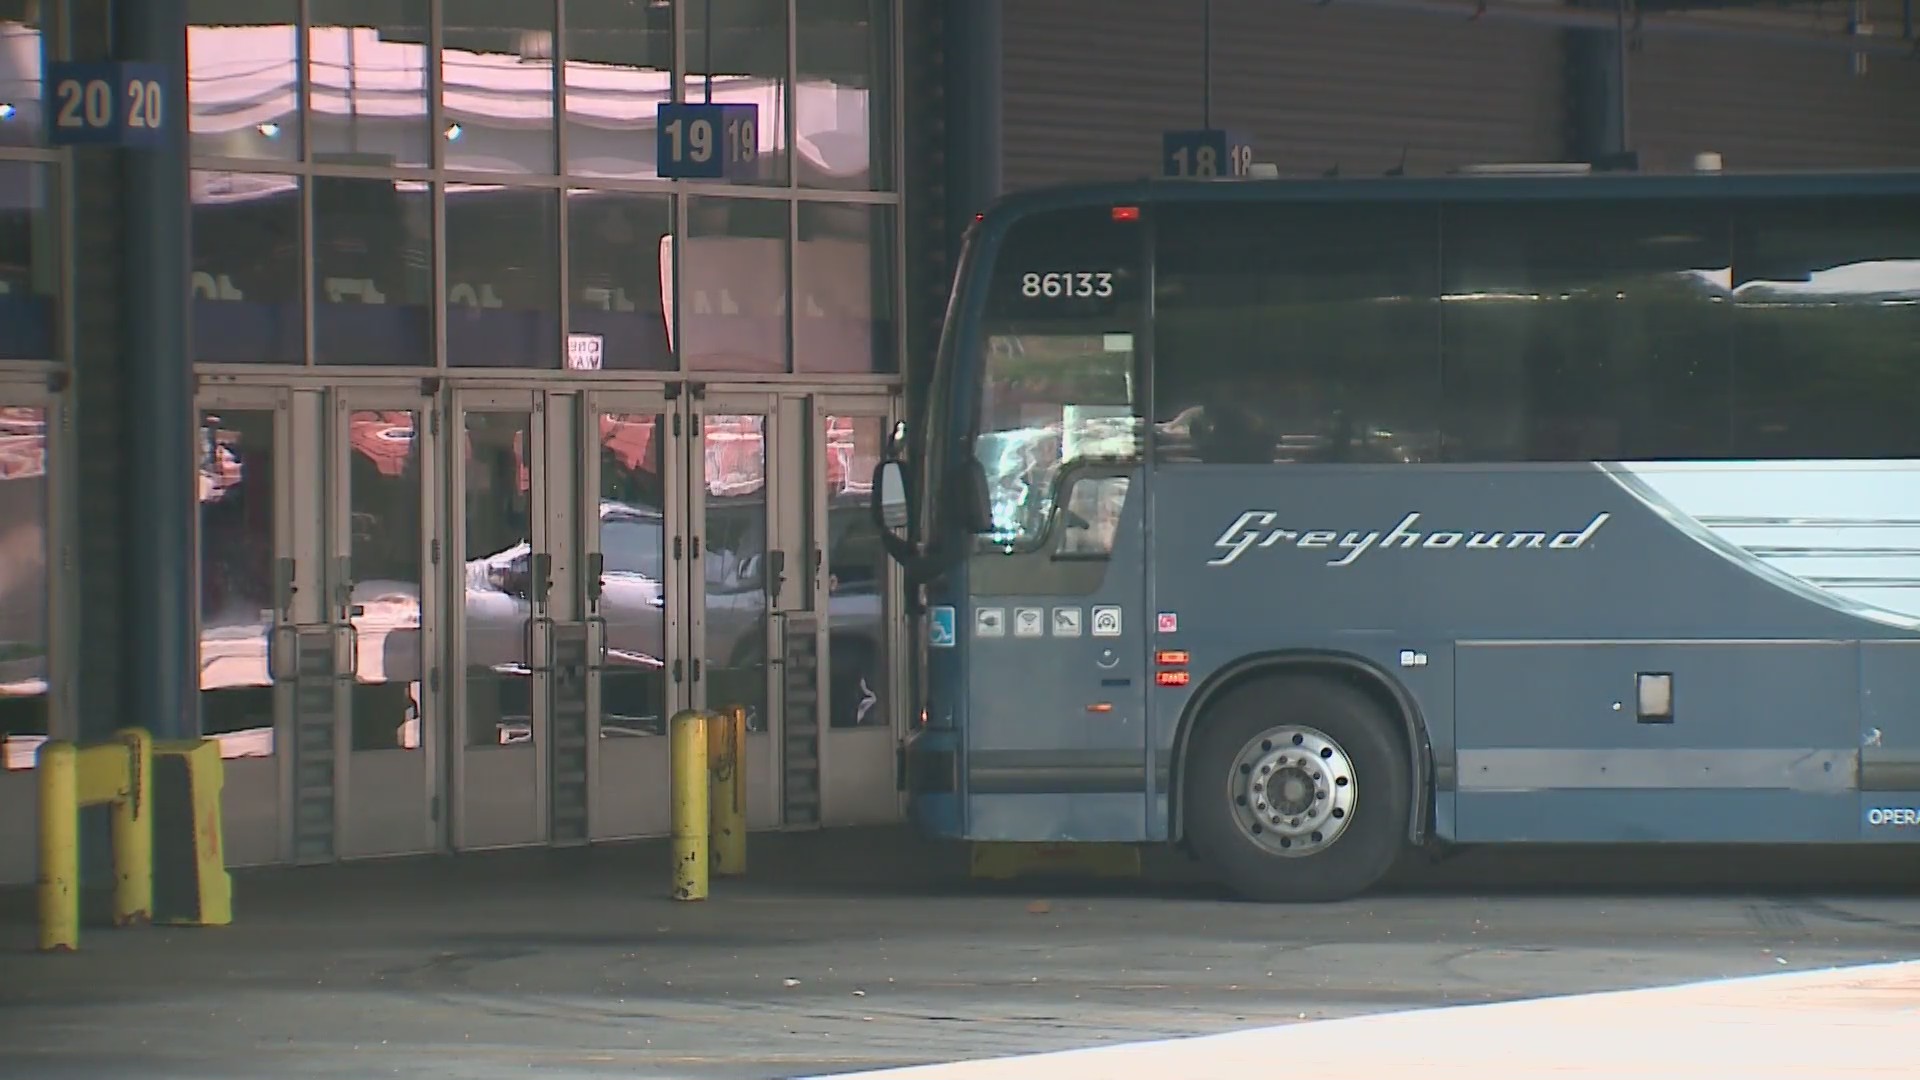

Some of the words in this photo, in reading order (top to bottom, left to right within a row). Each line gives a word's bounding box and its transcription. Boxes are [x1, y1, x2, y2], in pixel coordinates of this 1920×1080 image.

[57, 79, 111, 127] 20
[128, 79, 161, 128] 20
[665, 119, 713, 162] 19
[728, 119, 755, 162] 19
[1172, 145, 1217, 176] 18
[1022, 272, 1113, 297] 86133
[1206, 509, 1612, 567] Greyhound
